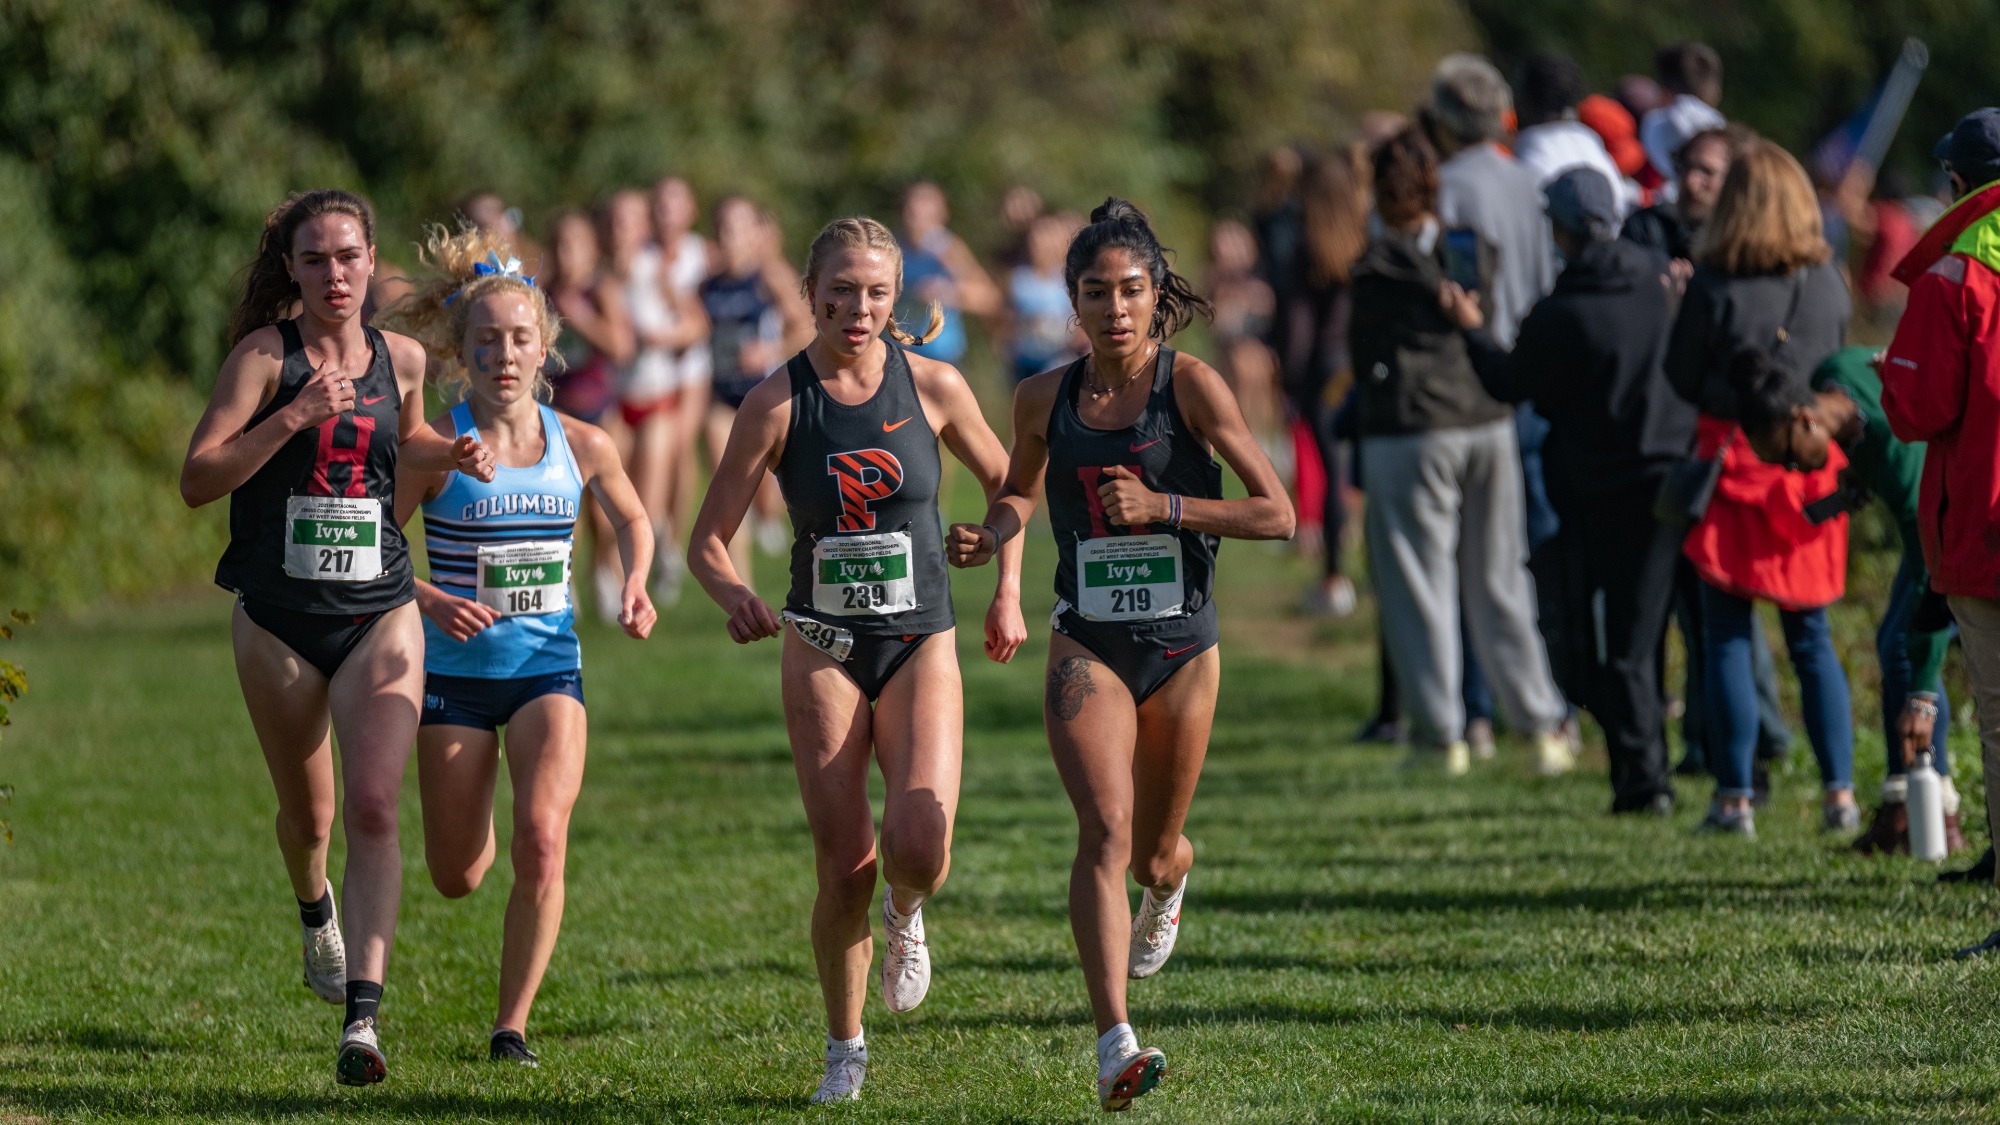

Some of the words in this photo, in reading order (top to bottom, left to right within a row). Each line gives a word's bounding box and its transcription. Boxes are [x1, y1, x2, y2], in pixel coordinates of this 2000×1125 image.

[307, 414, 376, 497] H
[826, 448, 904, 533] P
[461, 493, 576, 521] COLUMBIA
[315, 522, 344, 543] Ivy
[862, 543, 900, 552] CHAMPIONSHIPS
[319, 549, 354, 573] 217
[839, 561, 868, 579] Ivy
[1106, 563, 1136, 582] Ivy
[505, 566, 531, 585] Ivy
[507, 589, 543, 613] 164
[842, 584, 886, 609] 239
[1110, 587, 1152, 613] 219
